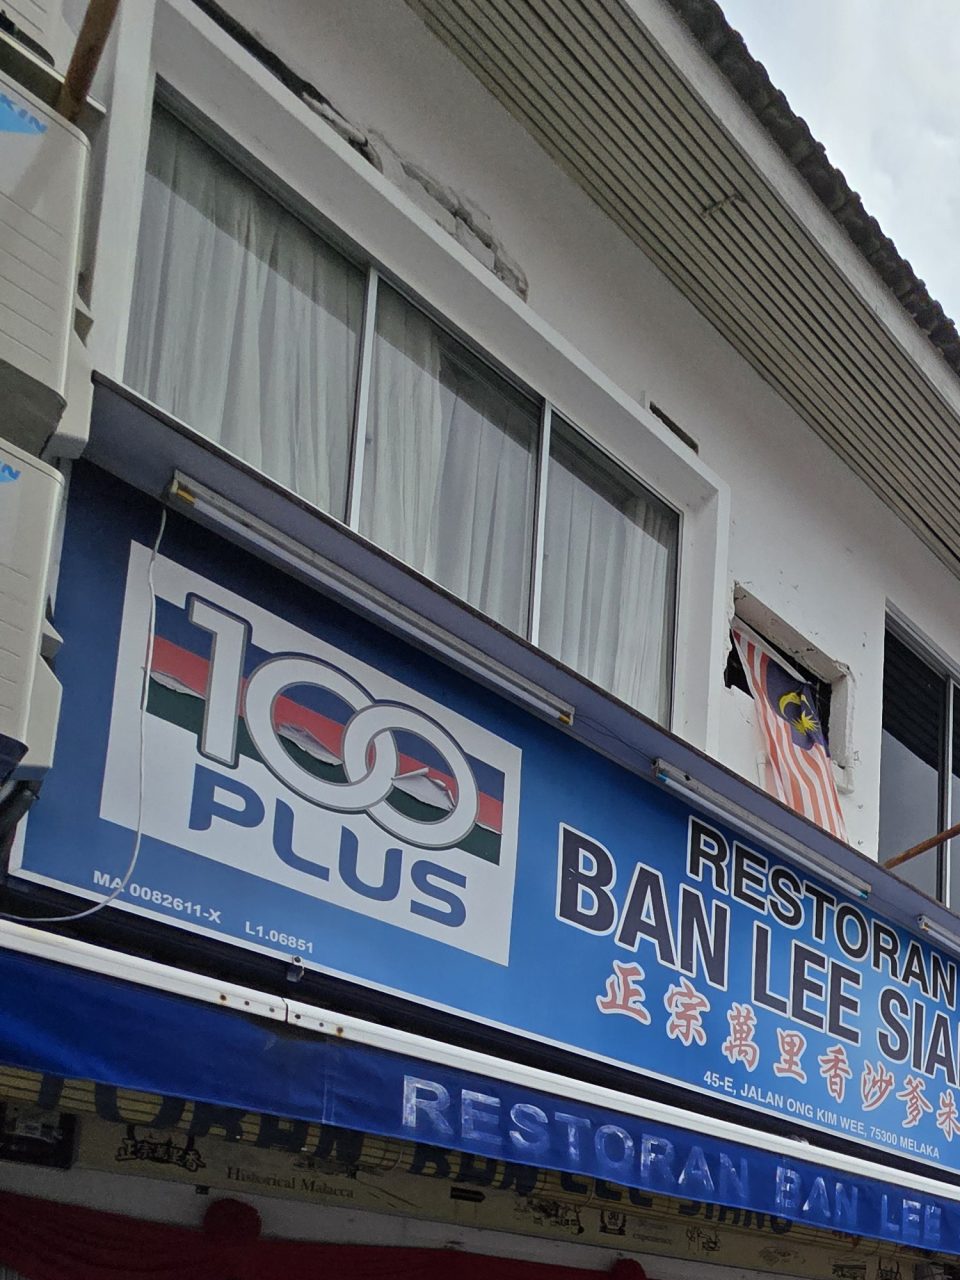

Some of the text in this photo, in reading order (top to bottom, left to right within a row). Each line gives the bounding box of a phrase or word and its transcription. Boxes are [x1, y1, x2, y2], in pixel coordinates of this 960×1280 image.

[186, 592, 478, 851] 100
[93, 870, 315, 954] MA 0082611-X L1.06851
[188, 763, 467, 929] PLUS
[687, 814, 958, 1011] RESTORAN
[555, 821, 730, 992] BAN
[751, 920, 862, 1046] LEE
[227, 1166, 354, 1199] Historical Malacca
[402, 1075, 750, 1200] RESTORAN
[774, 1165, 859, 1218] BAN
[881, 1194, 942, 1241] LEE
[703, 1071, 940, 1159] 45-E, JALAN ONG KIM WEE, 75300 MELAKA
